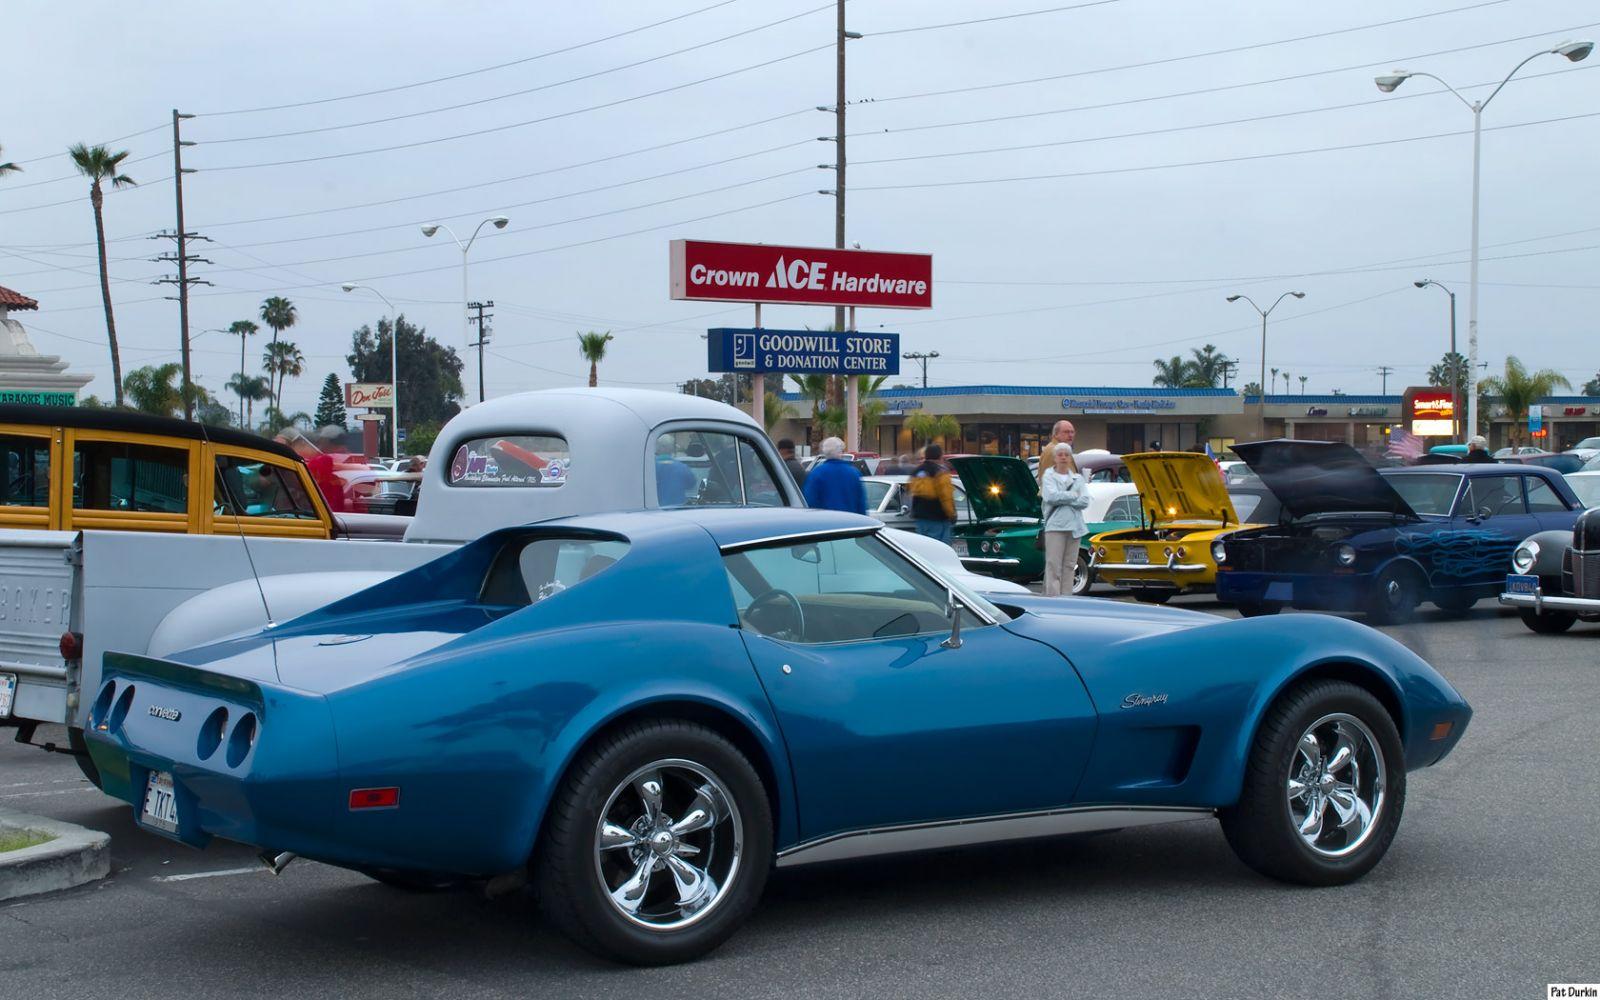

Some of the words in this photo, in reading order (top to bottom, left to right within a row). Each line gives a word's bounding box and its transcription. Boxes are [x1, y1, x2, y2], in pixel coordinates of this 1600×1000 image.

[690, 264, 759, 287] Crown
[765, 255, 828, 290] ACE
[832, 271, 927, 295] Hardware
[759, 334, 840, 353] GOODWILL
[846, 337, 892, 354] STORE
[765, 354, 773, 367] &
[777, 355, 839, 369] DONATION
[843, 356, 887, 370] CENTER
[43, 394, 76, 407] MUSIC
[351, 390, 371, 405] Don
